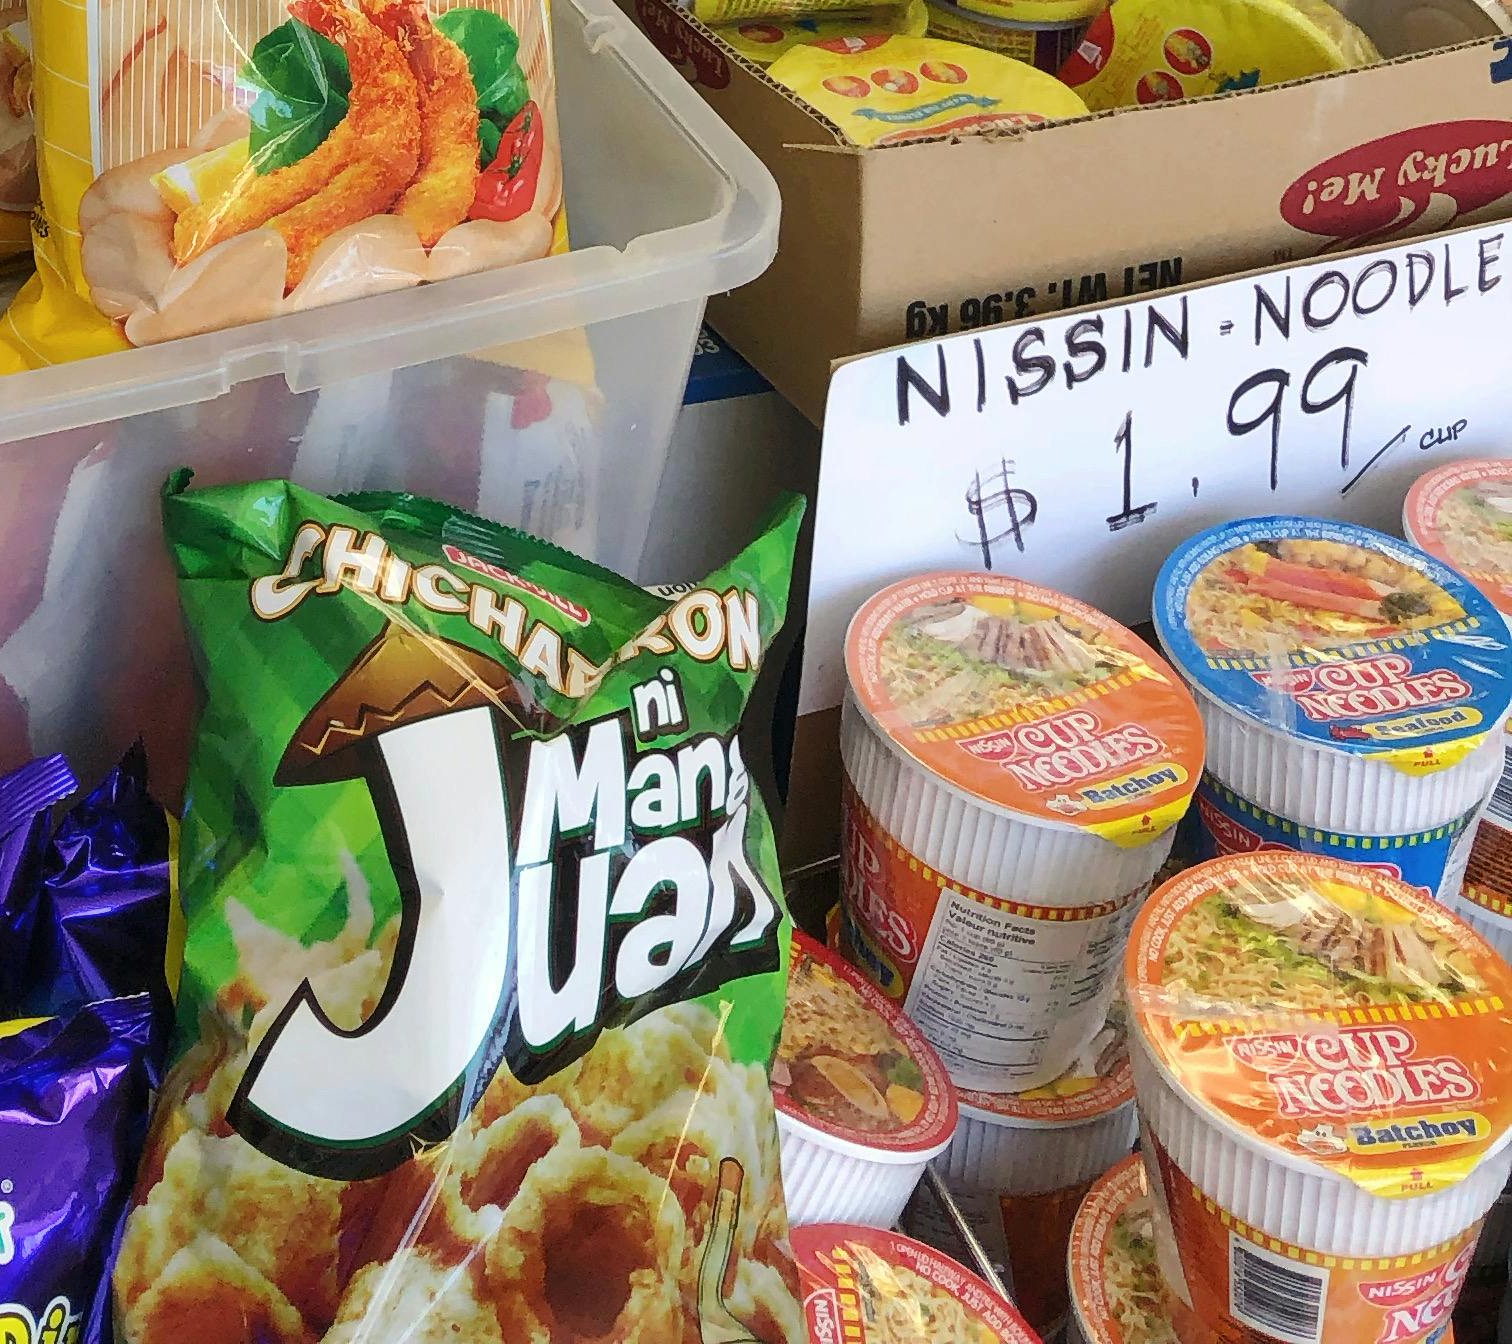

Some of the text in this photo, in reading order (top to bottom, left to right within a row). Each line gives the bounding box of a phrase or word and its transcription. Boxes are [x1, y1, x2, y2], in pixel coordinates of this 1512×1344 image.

[1300, 165, 1387, 215] Me!
[895, 232, 1506, 426] NISSIN NOODLE
[1295, 670, 1471, 721] NOODLES
[1317, 657, 1408, 693] CUP
[632, 667, 683, 732] ni
[968, 711, 1101, 758] NISSIN CUP
[1374, 709, 1467, 735] Seafood
[1002, 723, 1165, 793] NOODLES
[1081, 764, 1180, 805] Batchoy
[948, 909, 1036, 946] Valeur nutritive
[949, 900, 1036, 937] Nutrition Facts
[1236, 1026, 1414, 1070] NISSIN CUP
[1274, 1060, 1475, 1115] NOODLES
[1353, 1117, 1478, 1147] Batchoy
[1400, 1181, 1434, 1194] PULL
[1367, 1271, 1438, 1300] NISSIN
